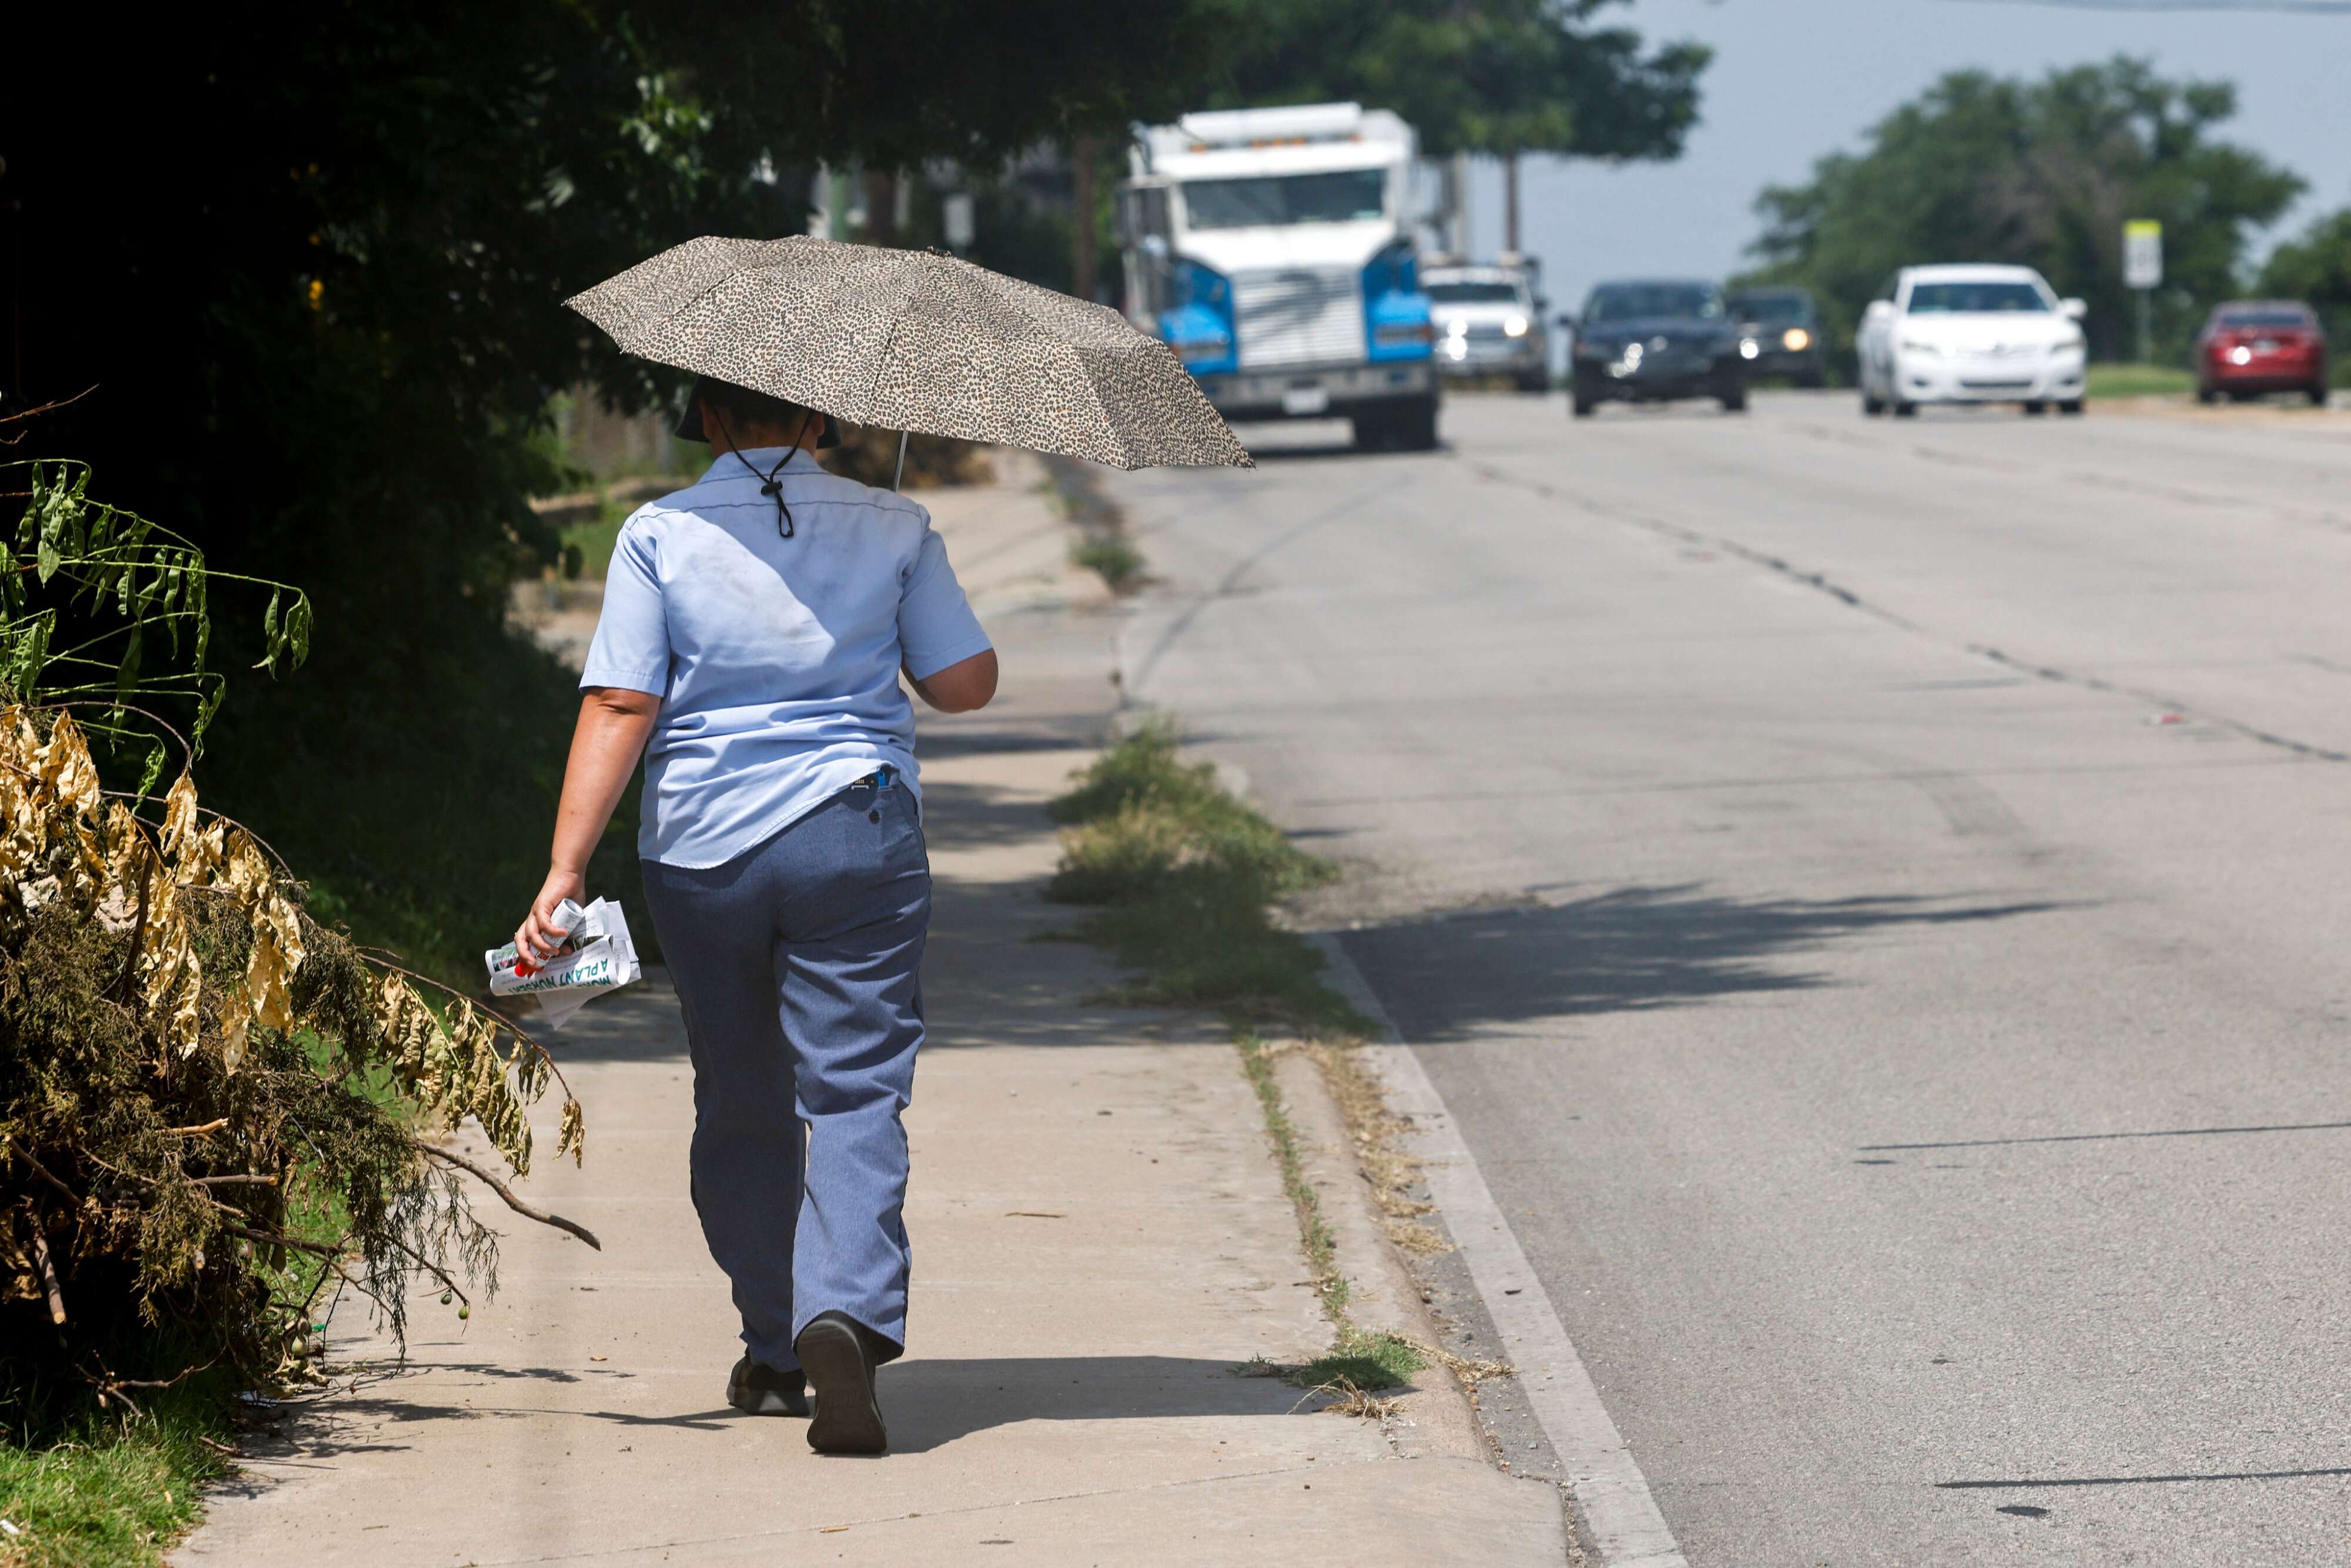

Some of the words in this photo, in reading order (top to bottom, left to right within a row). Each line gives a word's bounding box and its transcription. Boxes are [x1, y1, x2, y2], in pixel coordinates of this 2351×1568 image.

[601, 957, 608, 972] A
[559, 962, 598, 987] PLANT
[576, 974, 611, 987] MO
